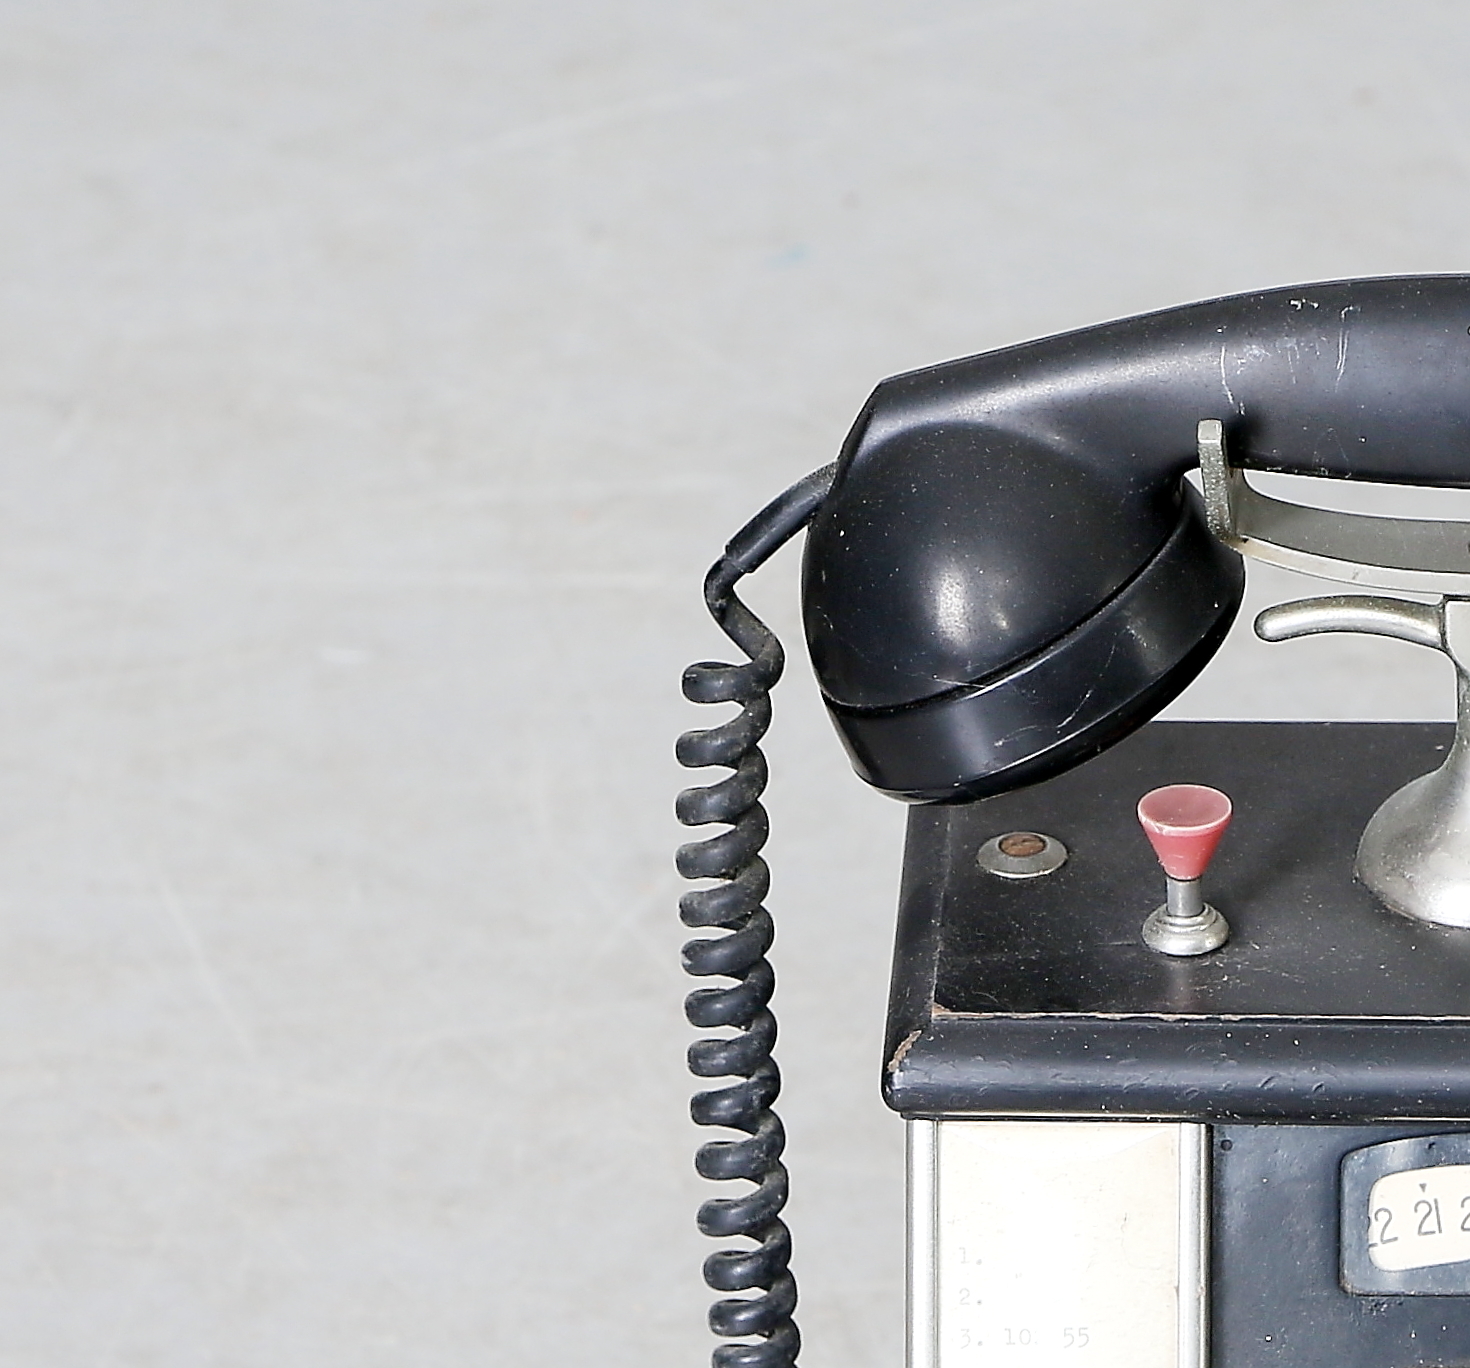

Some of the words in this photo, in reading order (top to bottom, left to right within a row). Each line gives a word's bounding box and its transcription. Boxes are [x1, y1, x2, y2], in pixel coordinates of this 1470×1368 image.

[1414, 1198, 1443, 1236] 21
[960, 1328, 983, 1349] 3.
[1063, 1327, 1090, 1348] 55
